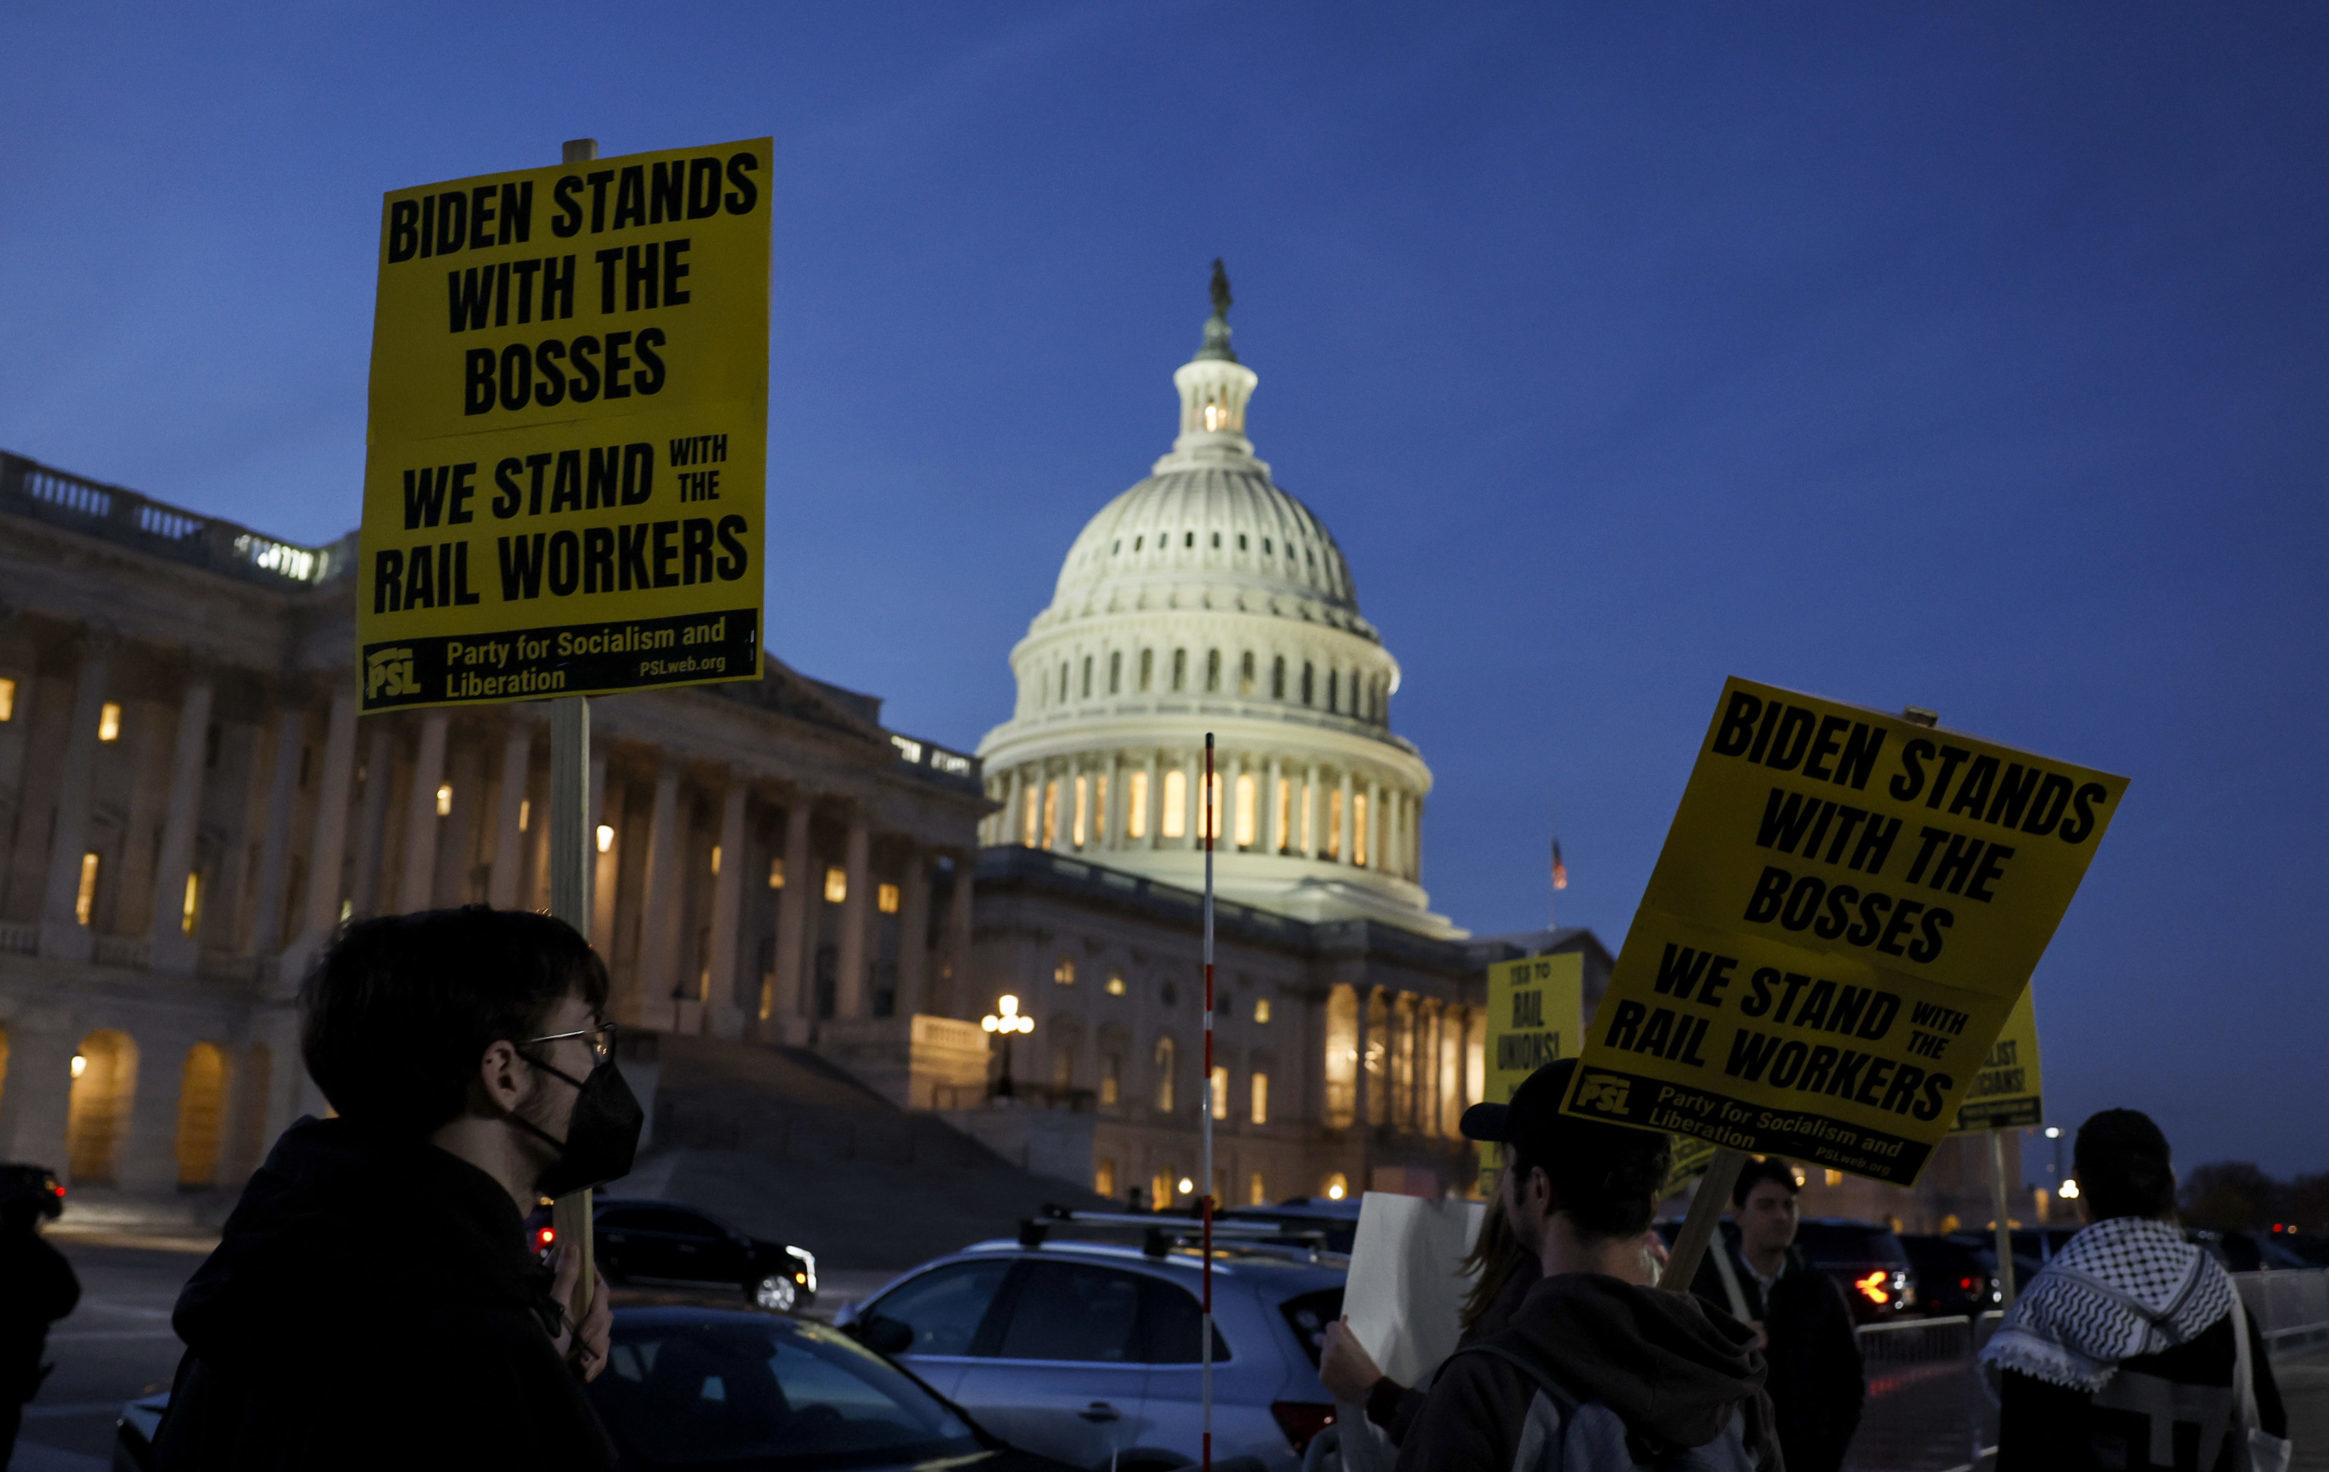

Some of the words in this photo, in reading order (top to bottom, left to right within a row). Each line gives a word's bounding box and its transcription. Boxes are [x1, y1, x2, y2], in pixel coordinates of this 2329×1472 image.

[388, 181, 533, 264] BIDEN
[551, 153, 758, 238] STANDS
[449, 254, 576, 333] WITH
[596, 238, 690, 314] THE
[464, 327, 666, 417] BOSSES
[670, 434, 728, 467] WITH
[404, 462, 477, 530] WE
[492, 442, 654, 519] STAND
[678, 470, 720, 502] THE
[374, 541, 479, 614] RAIL
[498, 514, 748, 601] WORKERS
[446, 641, 511, 669] Party
[516, 634, 551, 661] for
[556, 625, 675, 657] Socialism
[682, 616, 726, 646] and
[639, 655, 726, 677] PSLweb.org
[368, 657, 422, 700] PSL
[446, 666, 566, 698] Liberation
[1713, 690, 1888, 790] BIDEN
[1890, 739, 2107, 843] STANDS
[1756, 787, 1903, 875] WITH
[1906, 826, 2015, 903] THE
[1744, 866, 1954, 964] BOSSES
[1534, 962, 1551, 979] TO
[1654, 943, 1739, 1007] WE
[1740, 966, 1901, 1041] STAND
[1512, 990, 1545, 1028] RAIL
[1910, 1000, 1969, 1036] WITH
[1604, 1000, 1710, 1068] RAIL
[1725, 1028, 1953, 1122] WORKERS
[1906, 1029, 1950, 1060] THE
[1576, 1079, 1632, 1116] PSL
[1656, 1085, 1717, 1118] Party
[1720, 1100, 1753, 1124] for
[1755, 1111, 1858, 1147] Socialism
[1860, 1136, 1904, 1158] and
[1648, 1106, 1757, 1150] Liberation
[1815, 1146, 1893, 1176] PSLweb.org
